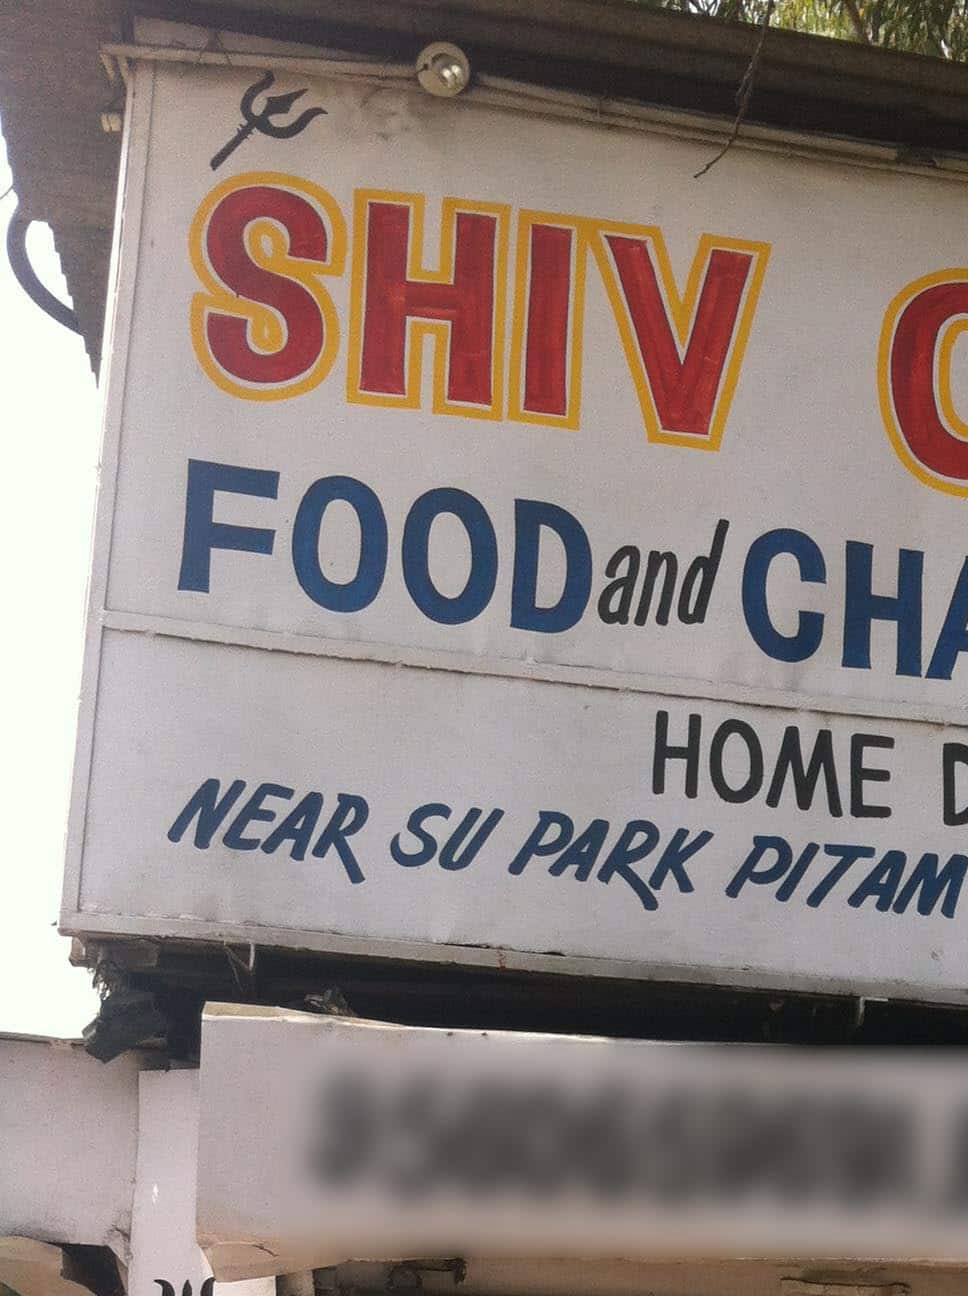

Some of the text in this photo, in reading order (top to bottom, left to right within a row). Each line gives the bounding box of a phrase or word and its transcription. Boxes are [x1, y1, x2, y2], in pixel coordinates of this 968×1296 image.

[189, 171, 772, 452] SHIV
[177, 458, 593, 634] FOOD
[598, 519, 730, 627] and
[652, 710, 895, 819] HOME
[167, 778, 369, 884] NEAR
[390, 803, 505, 871] SU
[507, 810, 715, 912] PARK
